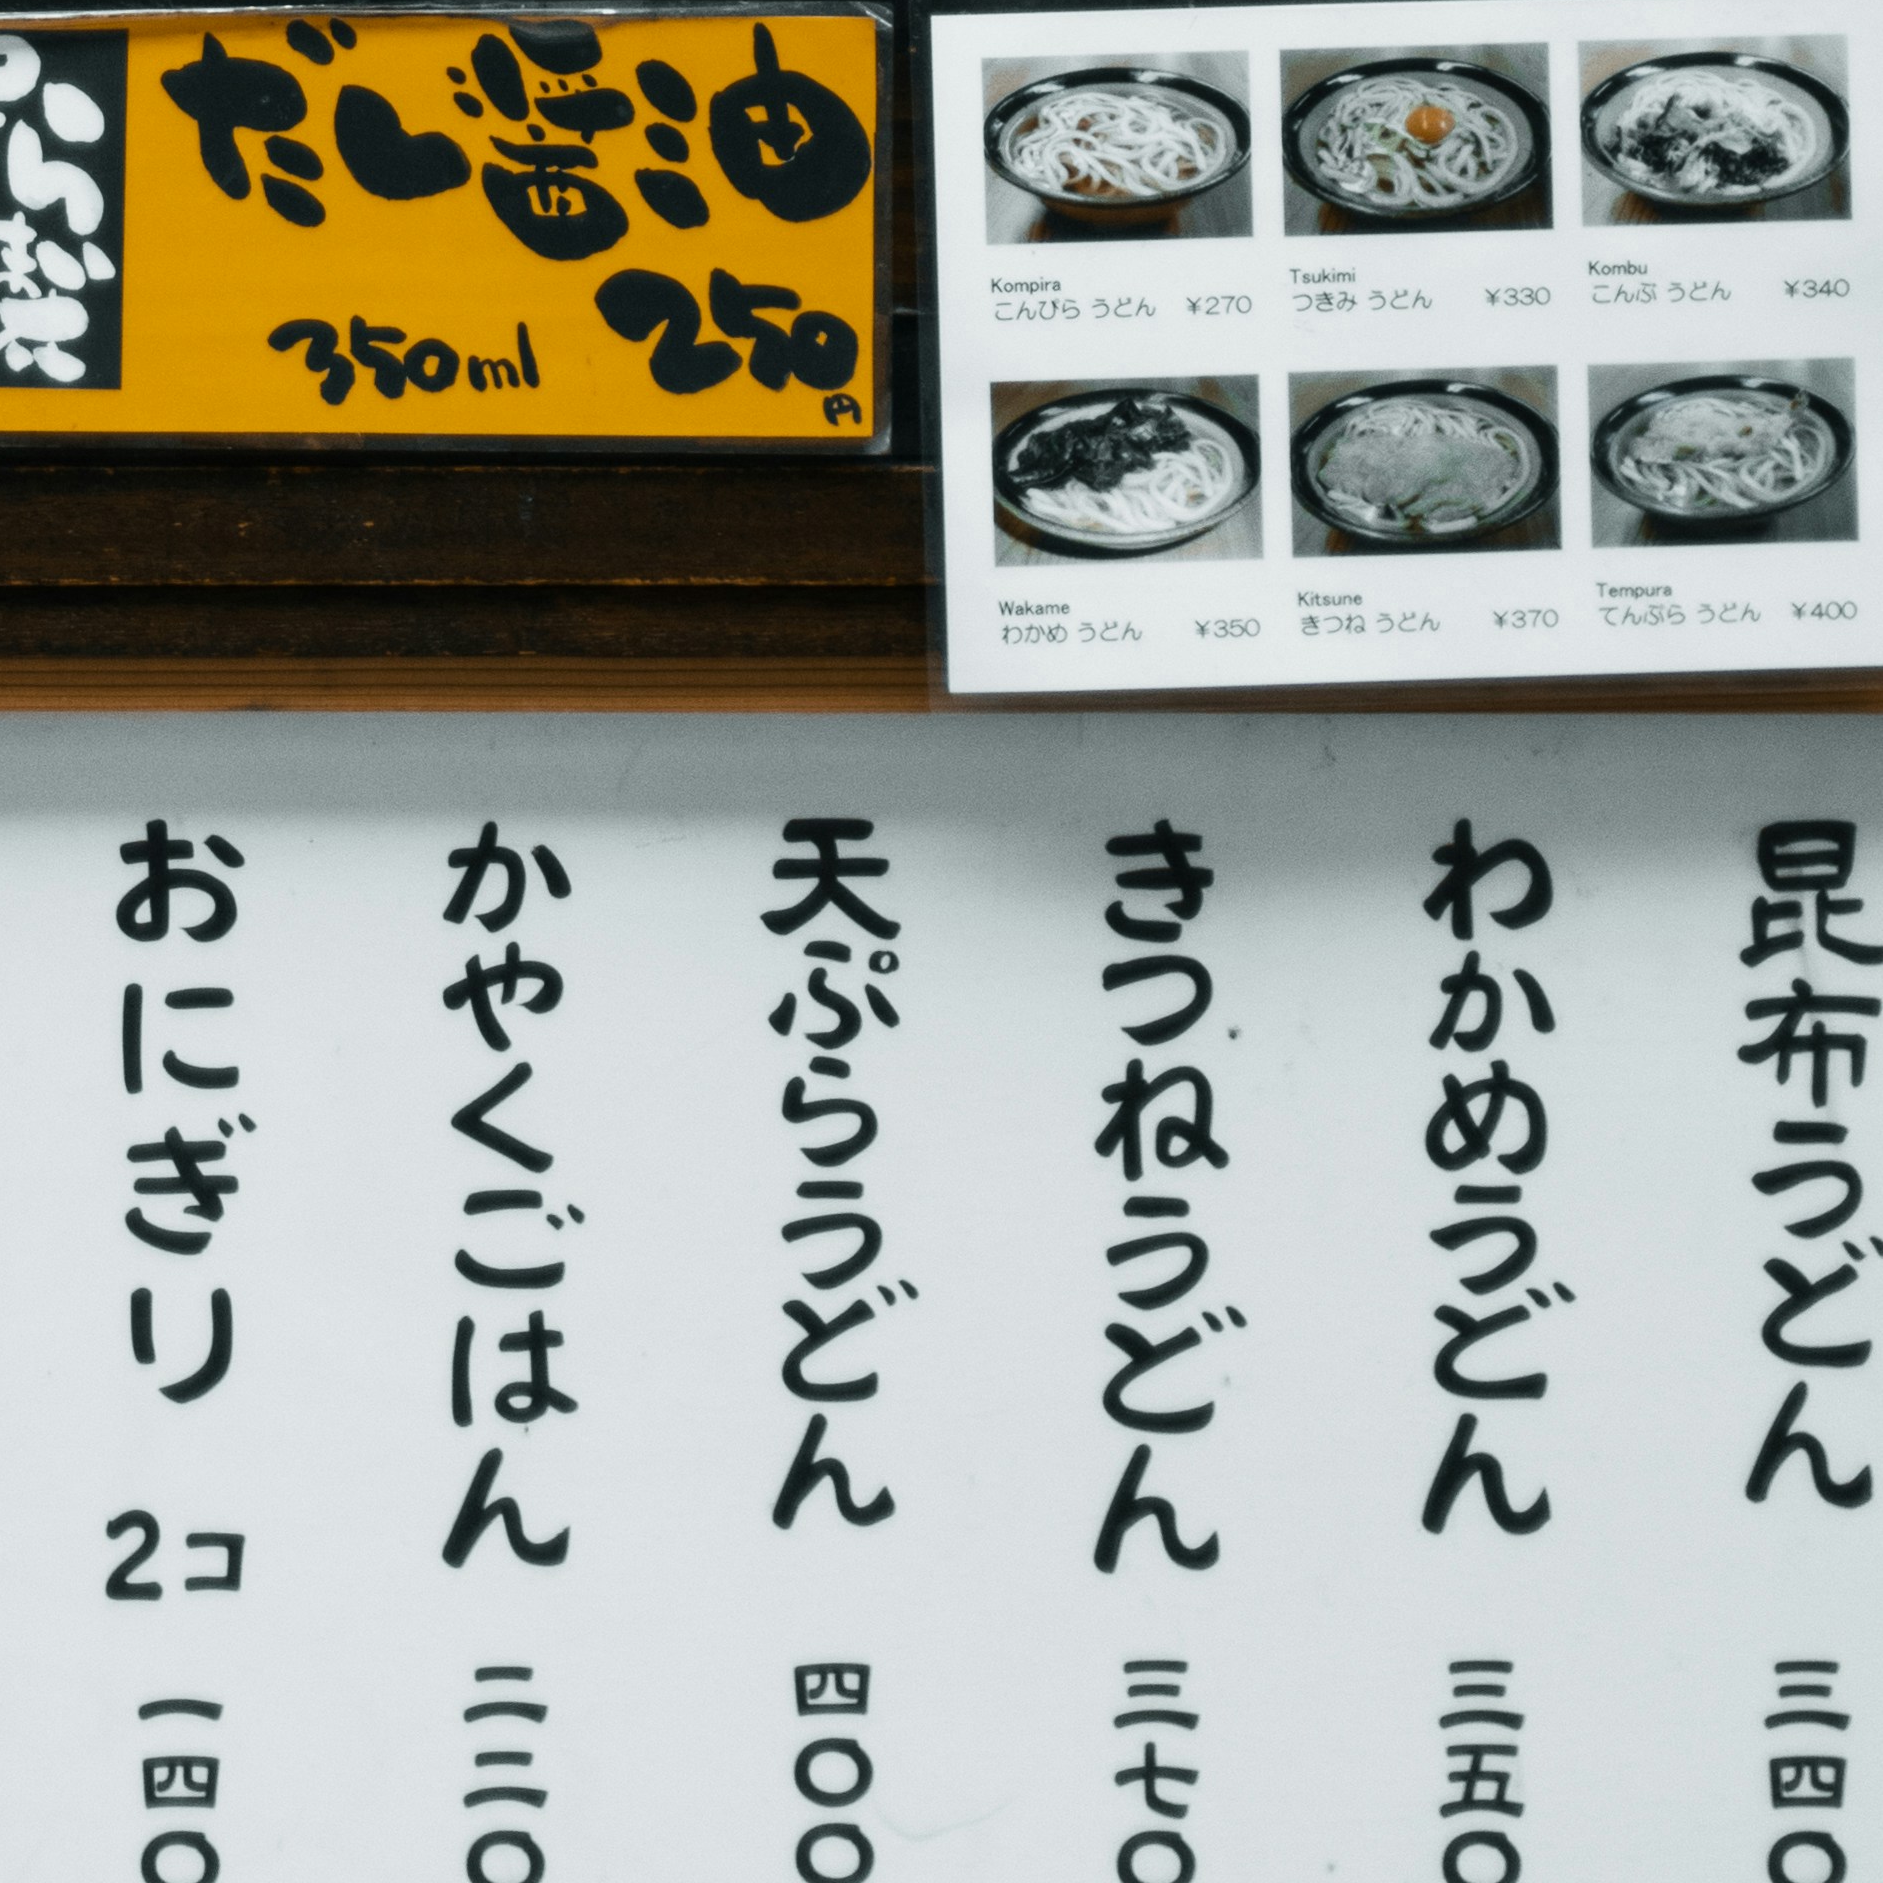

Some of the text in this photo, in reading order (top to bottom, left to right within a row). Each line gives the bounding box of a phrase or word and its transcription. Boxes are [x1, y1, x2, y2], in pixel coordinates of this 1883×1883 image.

[1287, 266, 1358, 287] Tsukimi
[1585, 258, 1650, 278] Kombu
[988, 276, 1064, 298] Kompira
[1294, 284, 1553, 315] つきみ うどん ¥330
[1589, 276, 1852, 307] こんぶ うどん ¥340
[992, 293, 1255, 324] こんぴら うどん ¥270
[594, 268, 859, 395] 250
[267, 314, 541, 406] 350ml
[823, 393, 862, 426] 円
[1295, 590, 1365, 609] Kitsune
[1594, 580, 1675, 602] Tempura
[996, 599, 1072, 619] Wakame
[1299, 606, 1561, 638] きつね うどん ¥370
[1597, 599, 1860, 629] てんぷら うどん ¥400
[999, 616, 1263, 646] わかめ うどん ¥350
[115, 817, 256, 1404] おにぎり
[759, 813, 918, 1530] 天ぷらうどん
[1421, 817, 1575, 1535] わかめうどん
[1737, 817, 1883, 1509] 昆布うどん
[441, 819, 585, 1569] かやくごはん
[1093, 817, 1247, 1574] きつねうどん
[105, 1509, 245, 1601] 2コ
